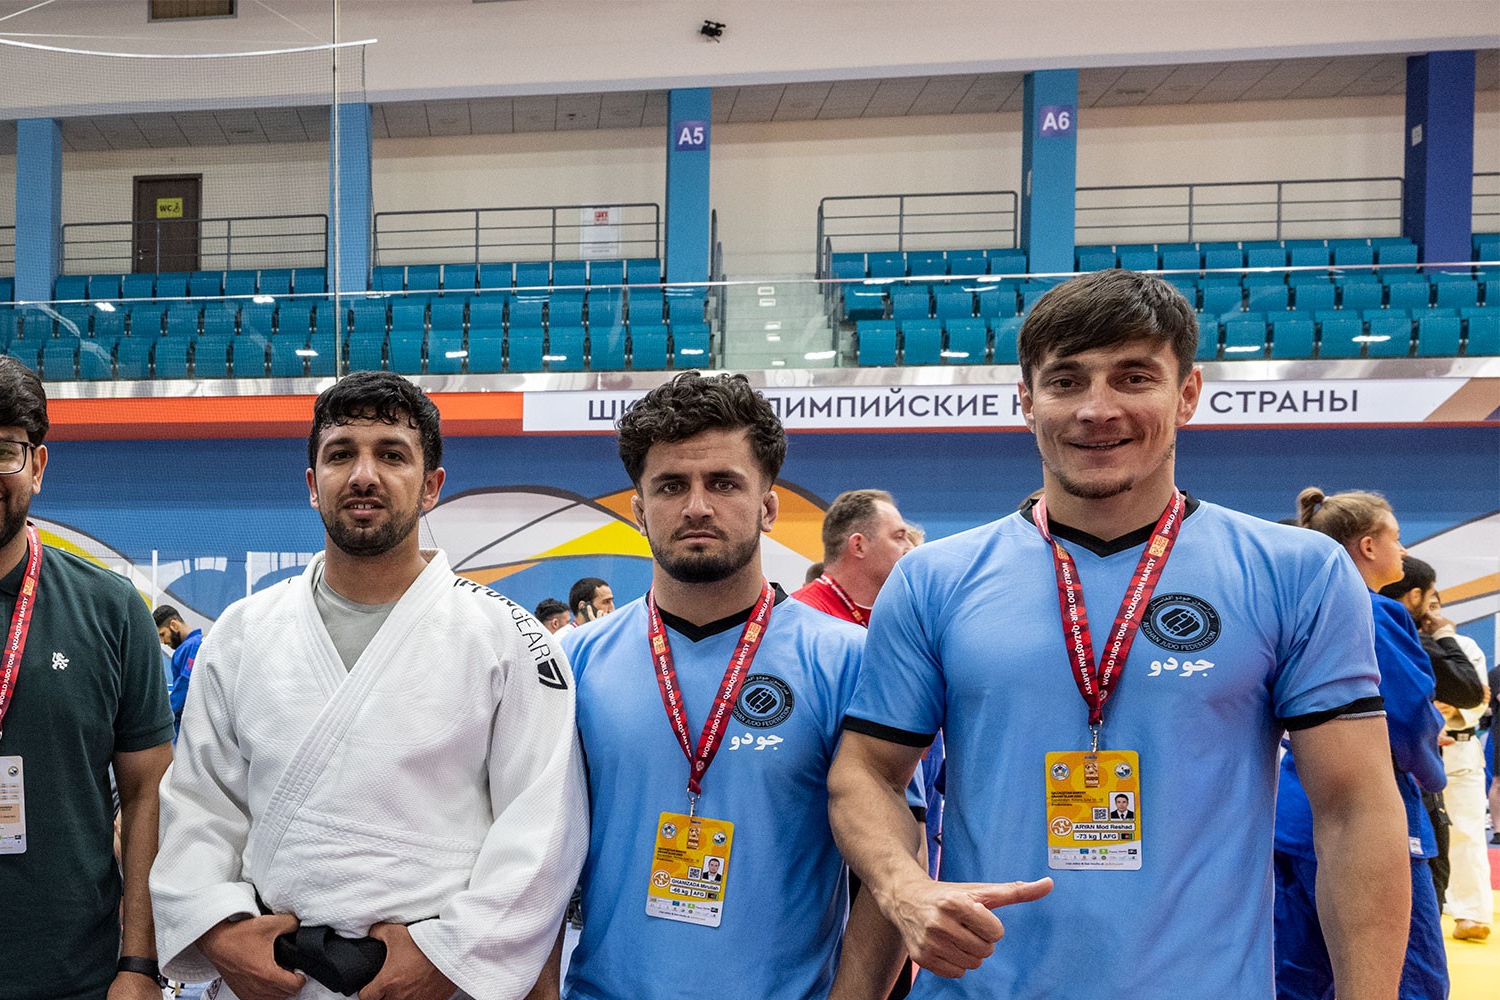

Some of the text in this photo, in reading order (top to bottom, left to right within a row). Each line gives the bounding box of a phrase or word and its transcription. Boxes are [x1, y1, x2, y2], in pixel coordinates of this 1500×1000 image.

[1042, 111, 1070, 131] A6
[678, 127, 704, 145] A5
[770, 388, 998, 421] ЛИМПИЙСКИЕ
[1209, 389, 1359, 413] СТРАНЫ
[1161, 513, 1175, 535] WORLD
[30, 553, 38, 576] WORLD
[1061, 562, 1072, 586] WORLD
[1066, 585, 1075, 603] JUDO
[18, 596, 29, 618] BARYSY
[756, 600, 768, 622] WORLD
[1069, 602, 1079, 621] TOUR
[1101, 659, 1115, 686] WORLD
[1109, 641, 1121, 662] JUDO
[1116, 623, 1129, 643] TOUR
[1124, 580, 1145, 621] QAZAQSTAN
[1140, 557, 1156, 583] BARYSY
[11, 615, 24, 651] QAZAQSTAN
[1142, 621, 1217, 651] AFGHAN JUDO FEDERATION
[1071, 625, 1087, 668] QAZAQSTAN
[7, 652, 15, 669] TOUR
[659, 655, 668, 676] WORLD
[3, 667, 12, 684] JUDO
[663, 675, 672, 691] JUDO
[1080, 666, 1093, 696] BARYSY
[702, 735, 714, 758] WORLD
[708, 718, 720, 737] JUDO
[715, 702, 726, 721] TOUR
[723, 663, 741, 701] QAZAQSTAN
[736, 643, 750, 666] BARYSY
[672, 708, 688, 745] QAZAQSTAN
